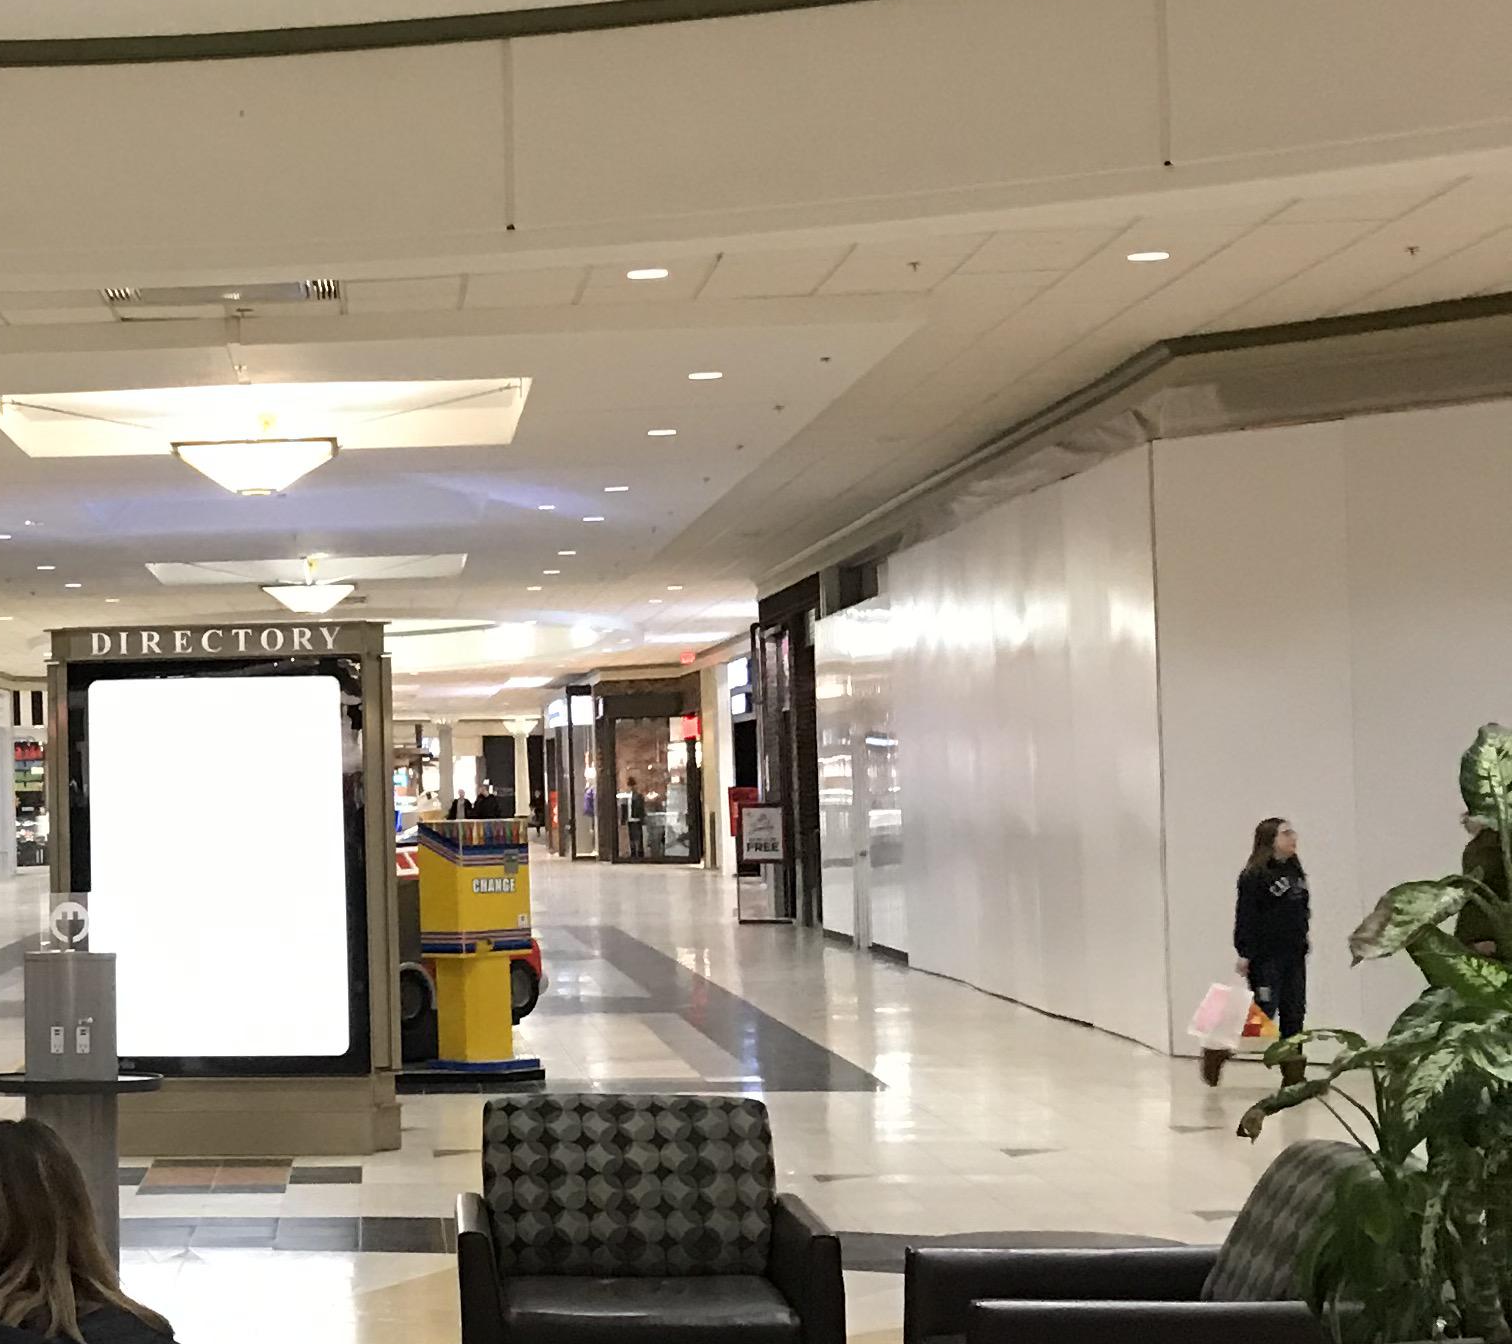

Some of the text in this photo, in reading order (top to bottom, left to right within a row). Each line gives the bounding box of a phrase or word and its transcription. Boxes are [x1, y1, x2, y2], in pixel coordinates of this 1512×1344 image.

[90, 626, 341, 656] DIRECTORY
[746, 841, 780, 853] FREE
[472, 877, 516, 894] CHANGE
